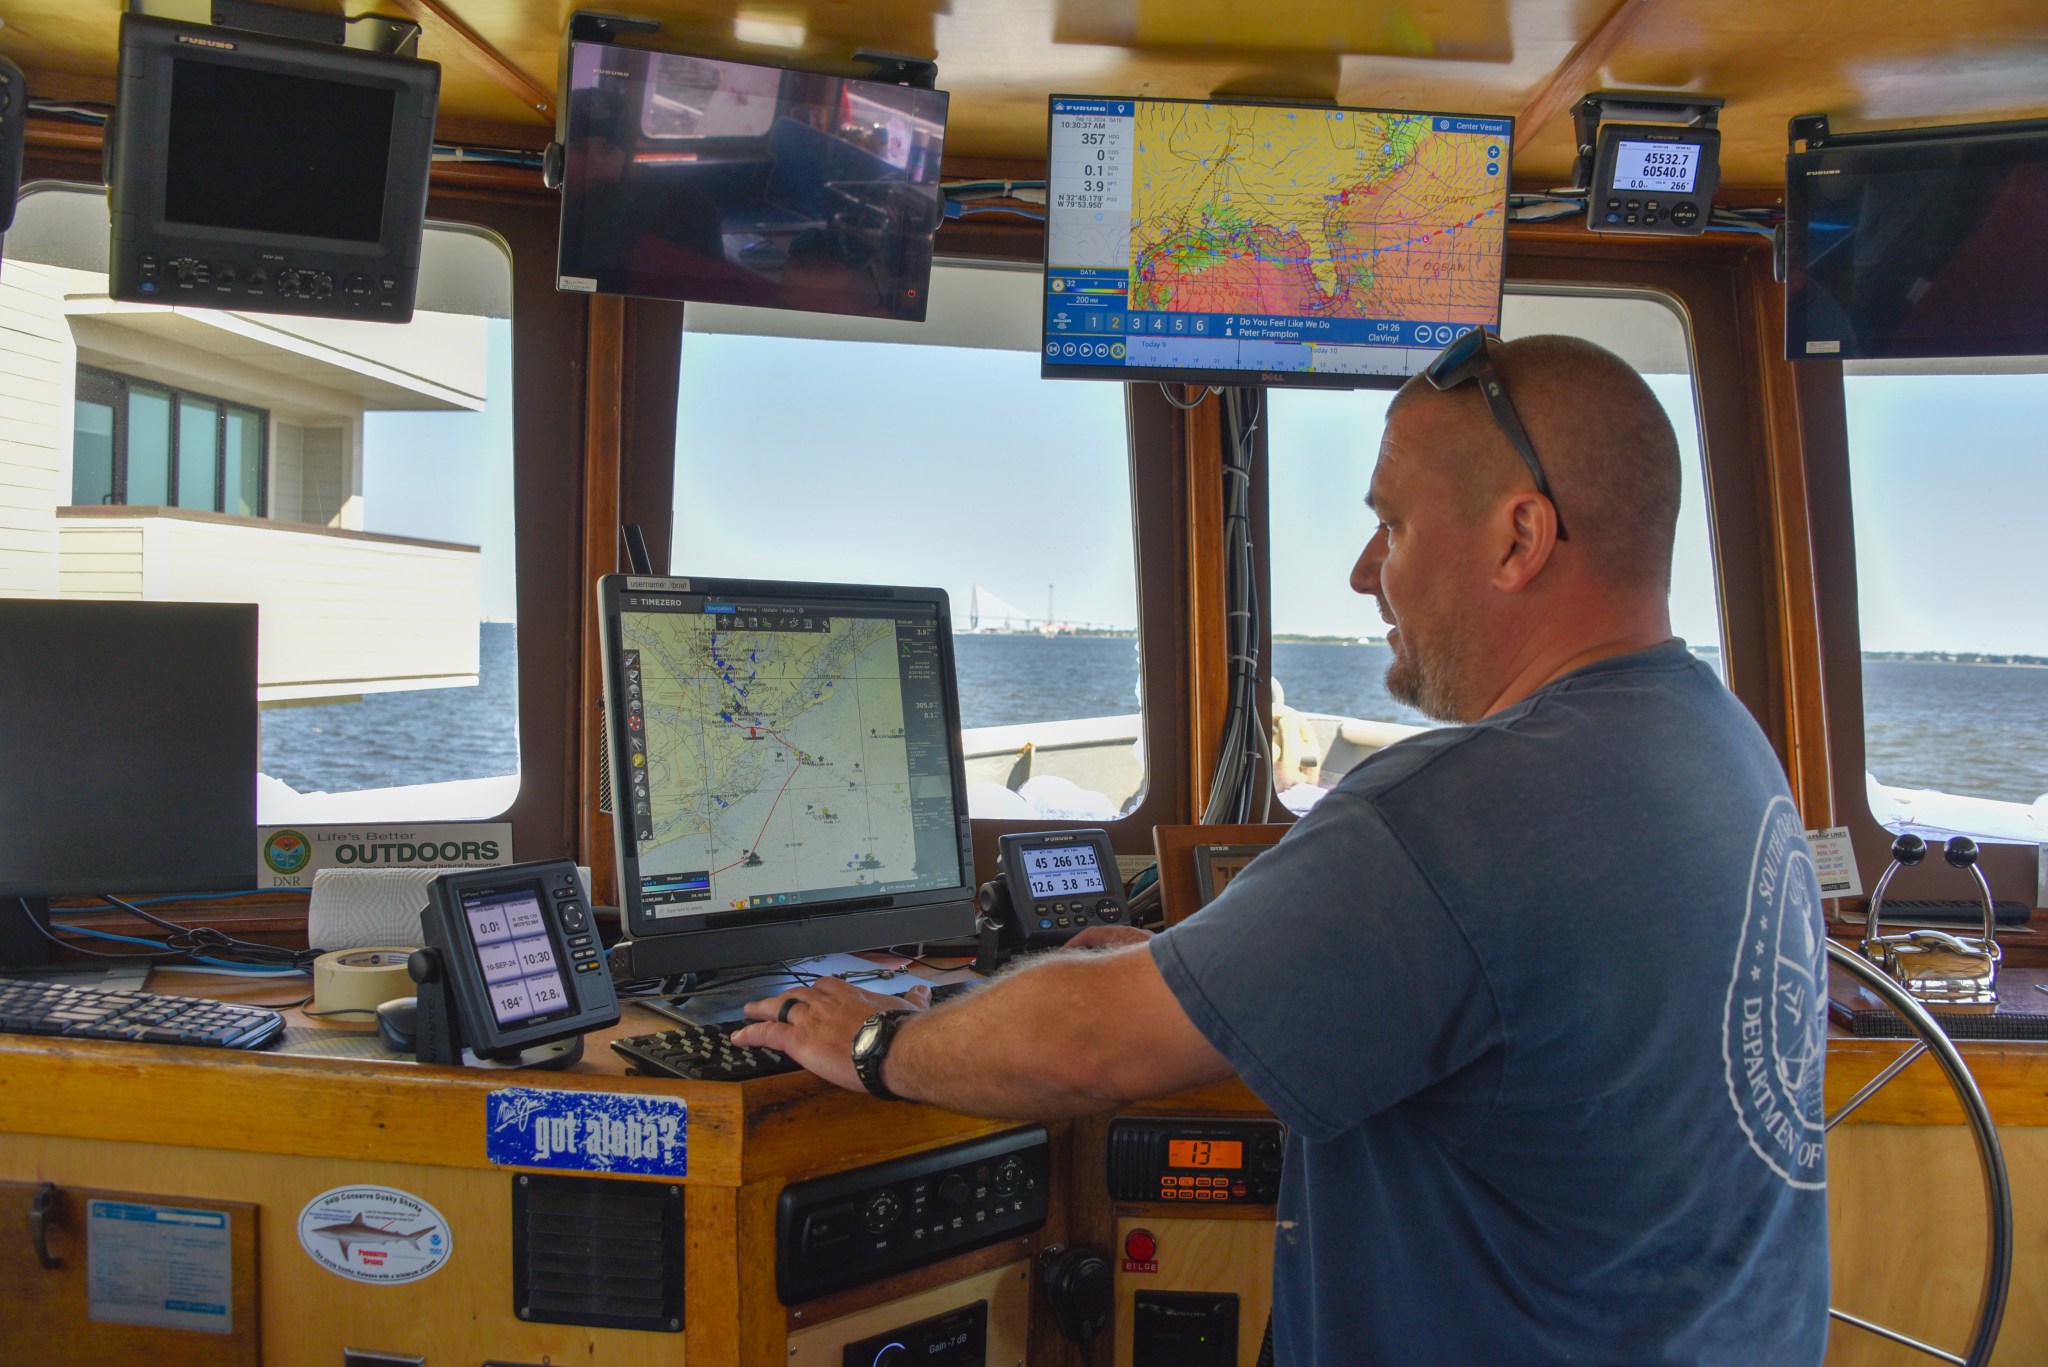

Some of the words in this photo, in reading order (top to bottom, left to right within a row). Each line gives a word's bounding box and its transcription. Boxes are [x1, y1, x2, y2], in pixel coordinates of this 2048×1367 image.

[179, 36, 234, 49] FURUNO
[1456, 122, 1479, 130] Center
[1081, 133, 1106, 145] 357
[1097, 150, 1105, 161] 0
[1644, 153, 1689, 166] 45532.7
[1084, 165, 1103, 177] 0.1
[1643, 166, 1687, 178] 60540.0
[1084, 180, 1104, 192] 3.9
[1630, 180, 1643, 188] 0.0
[1423, 262, 1467, 272] OCEAN
[1117, 281, 1126, 289] 91
[1076, 296, 1089, 304] 200
[1091, 317, 1097, 328] 1
[1111, 318, 1119, 329] 2
[1132, 318, 1140, 329] 3
[1153, 319, 1162, 330] 4
[1175, 320, 1183, 331] 5
[1196, 320, 1204, 331] 6
[1240, 318, 1250, 326] Do
[1252, 318, 1268, 327] You
[1269, 319, 1286, 327] Feel
[1288, 320, 1304, 328] Like
[1305, 320, 1317, 328] We
[1319, 321, 1330, 329] Do
[1390, 324, 1400, 332] 26
[1239, 329, 1260, 337] Peter
[1262, 330, 1299, 339] Frampton
[1261, 373, 1284, 381] DELL
[630, 580, 667, 589] username:
[640, 598, 682, 606] TIMEZERO
[316, 832, 361, 842] Life's
[366, 832, 417, 841] Better
[1830, 831, 1847, 839] LINES
[335, 841, 500, 864] OUTDOORS
[1035, 857, 1048, 869] 45
[1053, 855, 1072, 868] 266
[1075, 854, 1096, 866] 12.5
[1758, 828, 1785, 907] SOUTH
[273, 876, 301, 887] DNR
[1032, 880, 1054, 893] 12.6
[1062, 879, 1078, 891] 3.8
[1085, 878, 1102, 887] 75.2
[480, 921, 496, 934] 0.0
[523, 951, 551, 966] 10:30
[486, 960, 517, 972] 10-SEP-24
[535, 988, 556, 1003] 12.8
[1743, 997, 1800, 1155] DEPARTMEN
[1797, 1141, 1822, 1168] OF
[531, 1111, 577, 1160] got
[585, 1113, 678, 1164] aloha?
[1192, 1141, 1211, 1165] 13
[341, 1193, 374, 1201] Conserve
[376, 1193, 398, 1204] Dusky
[400, 1197, 422, 1213] Sharks
[1126, 1263, 1157, 1271] BILGE
[929, 1341, 947, 1354] Gain
[956, 1333, 968, 1344] dB
